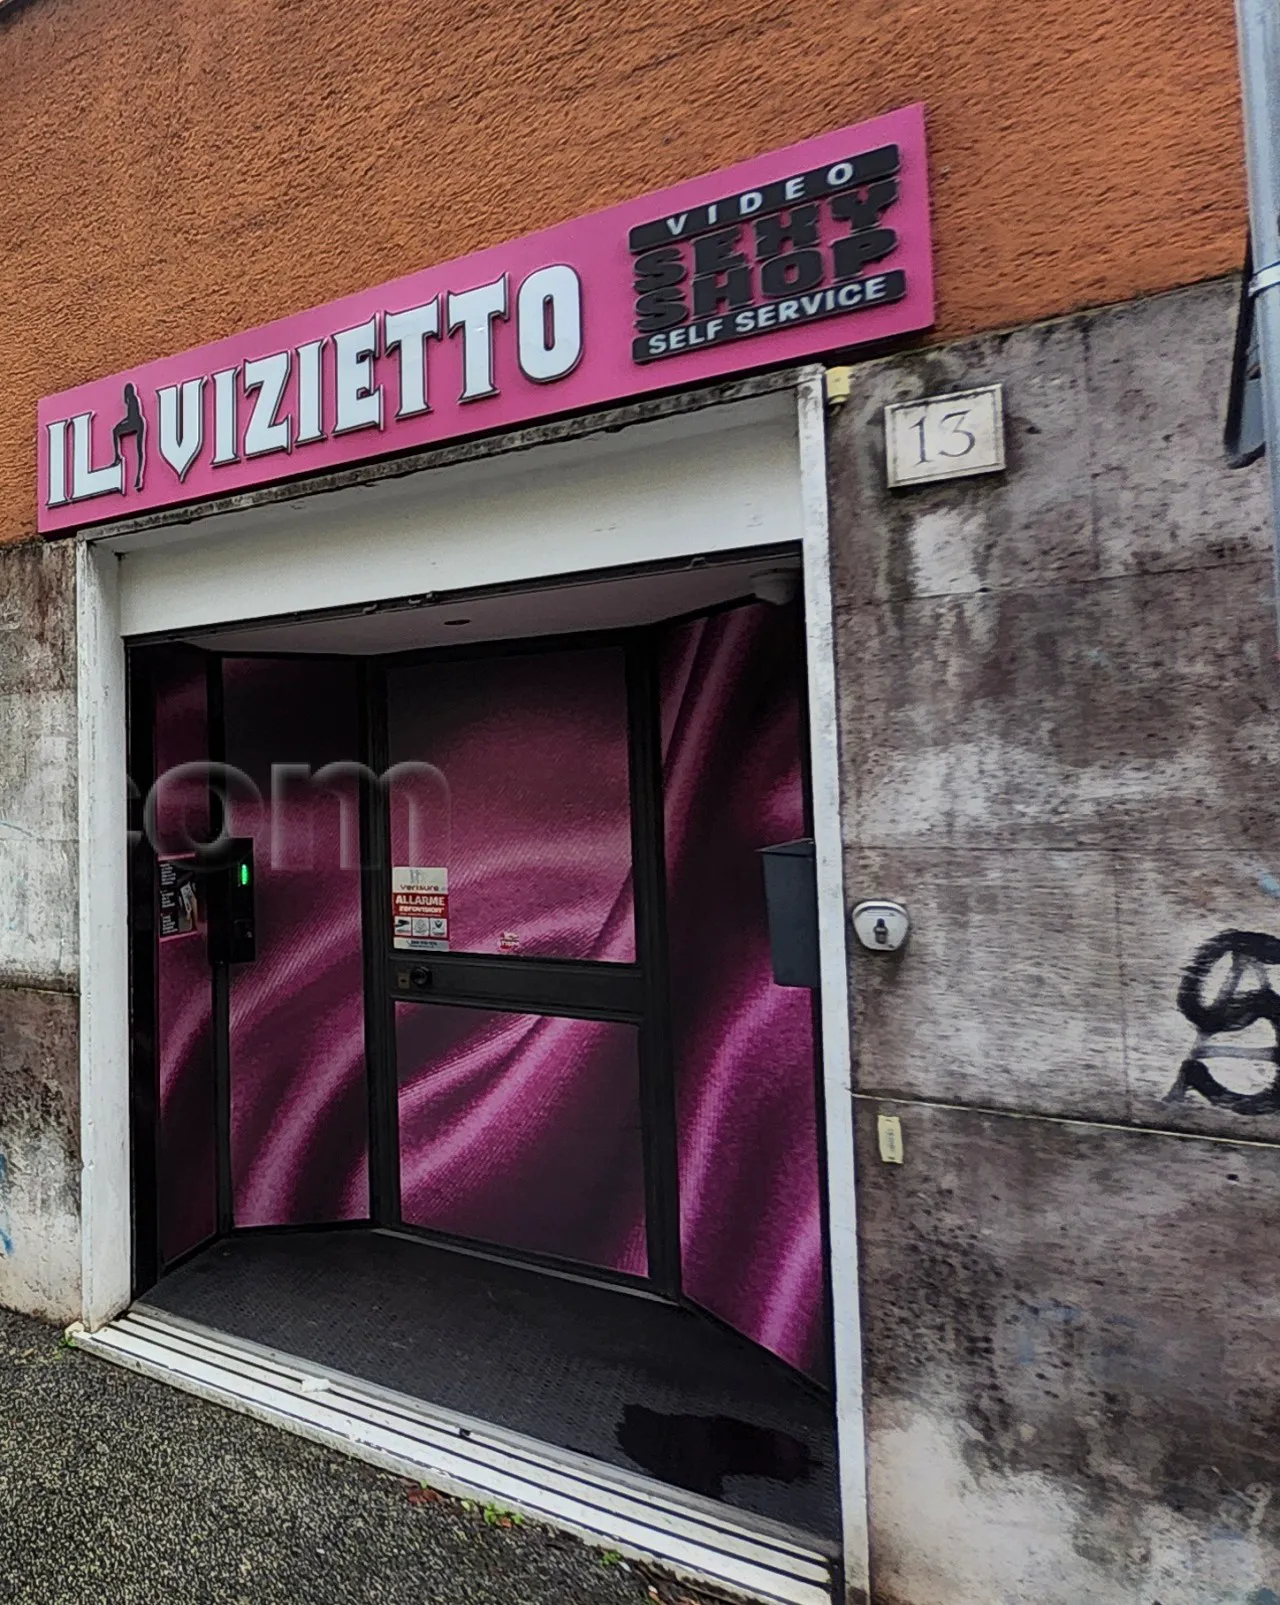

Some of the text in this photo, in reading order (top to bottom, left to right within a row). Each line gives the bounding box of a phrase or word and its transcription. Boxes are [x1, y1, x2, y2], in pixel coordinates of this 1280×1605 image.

[632, 175, 901, 293] SEXY
[666, 162, 854, 236] VIDEO
[633, 227, 899, 333] SHOP
[648, 275, 887, 355] SELF SERVICE
[46, 263, 584, 510] IL VIZIETTO
[908, 408, 976, 468] 13
[395, 895, 445, 906] ALLARME
